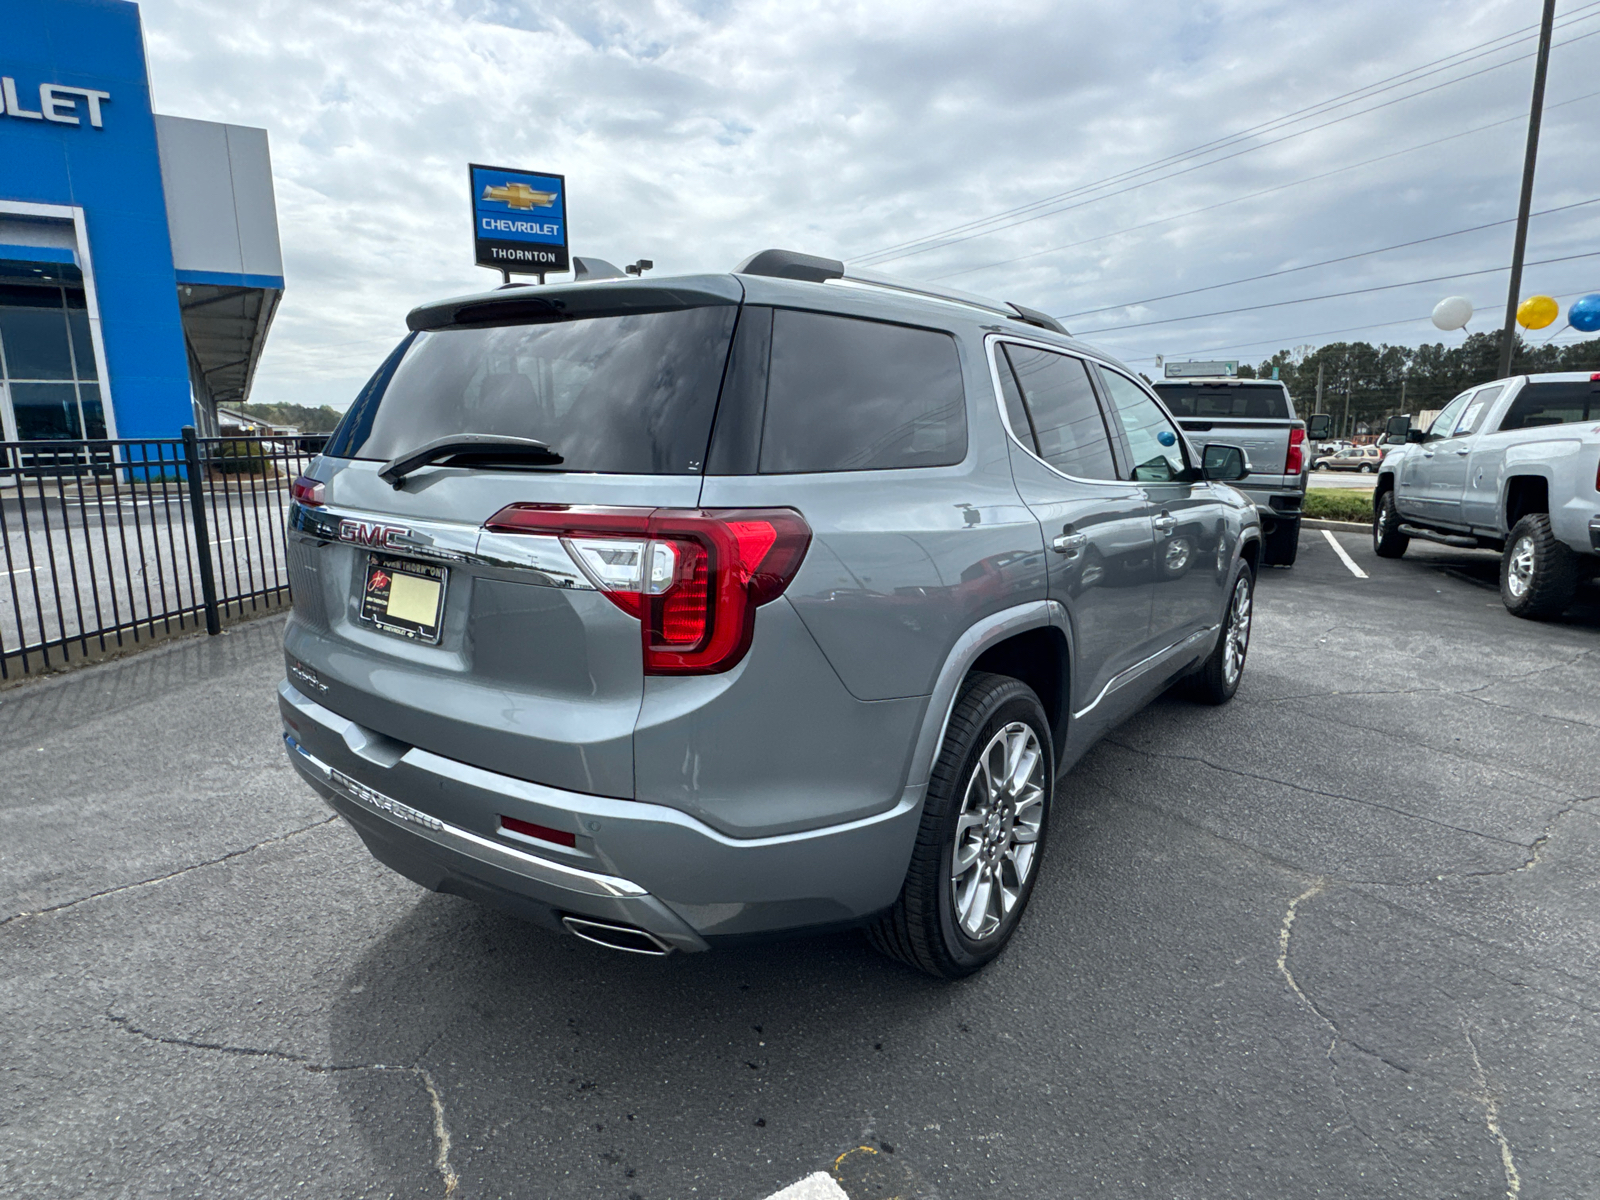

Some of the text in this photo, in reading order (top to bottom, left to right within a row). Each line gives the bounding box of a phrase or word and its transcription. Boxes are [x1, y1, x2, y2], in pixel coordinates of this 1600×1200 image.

[0, 77, 110, 127] LET
[482, 218, 559, 236] CHEVROLET
[491, 247, 556, 263] THORNTON
[339, 519, 414, 552] GMC
